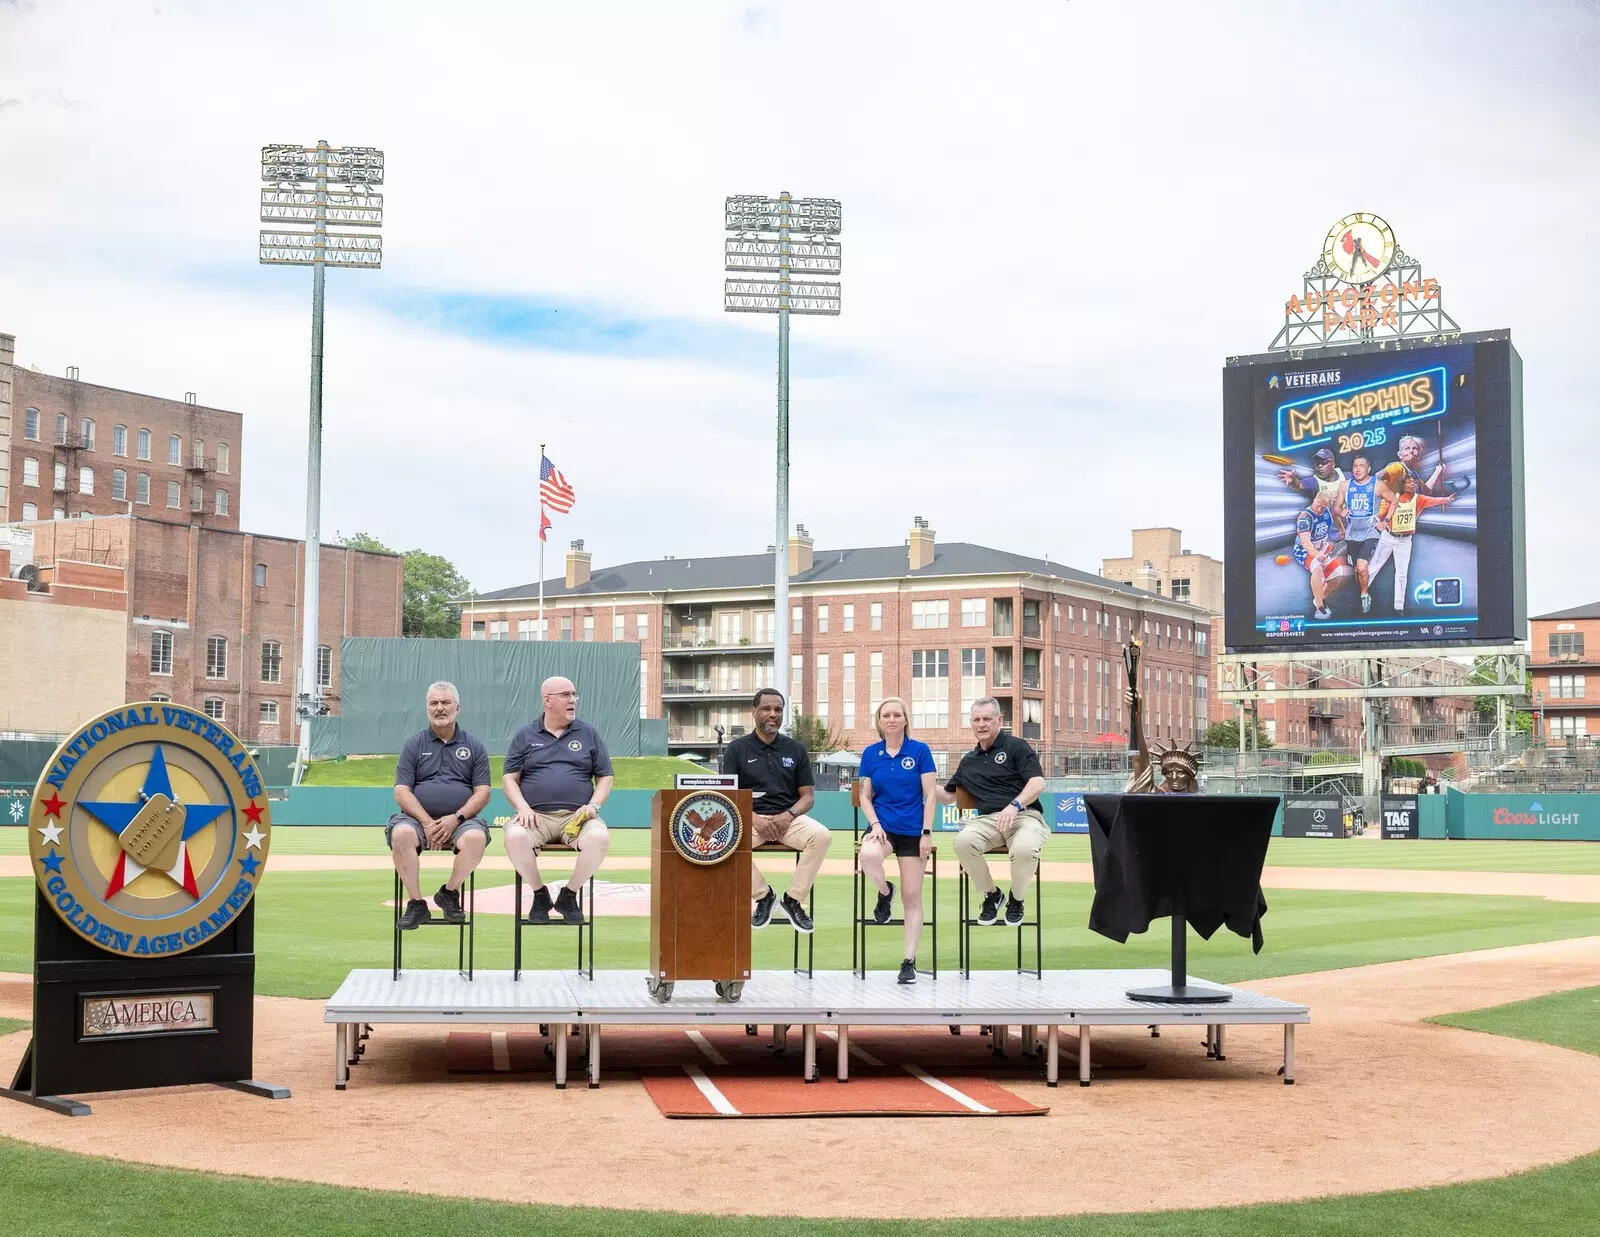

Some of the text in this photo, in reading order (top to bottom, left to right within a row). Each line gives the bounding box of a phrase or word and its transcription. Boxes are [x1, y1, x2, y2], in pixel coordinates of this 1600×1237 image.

[1286, 277, 1439, 316] AUTOZONE
[1324, 305, 1398, 332] PARK
[1285, 371, 1340, 387] VETERANS
[1290, 377, 1433, 441] MEMPHIS
[1324, 420, 1350, 433] MAY
[1338, 427, 1387, 453] 2025
[1352, 498, 1369, 510] 1075
[1397, 513, 1413, 525] 1797
[46, 707, 262, 800] NATIONAL VETERANS
[1384, 811, 1410, 827] TAG
[1493, 807, 1580, 825] Coors LIGHT
[47, 874, 254, 954] GOLDEN AGE GAMES
[103, 999, 197, 1025] AMERICA
